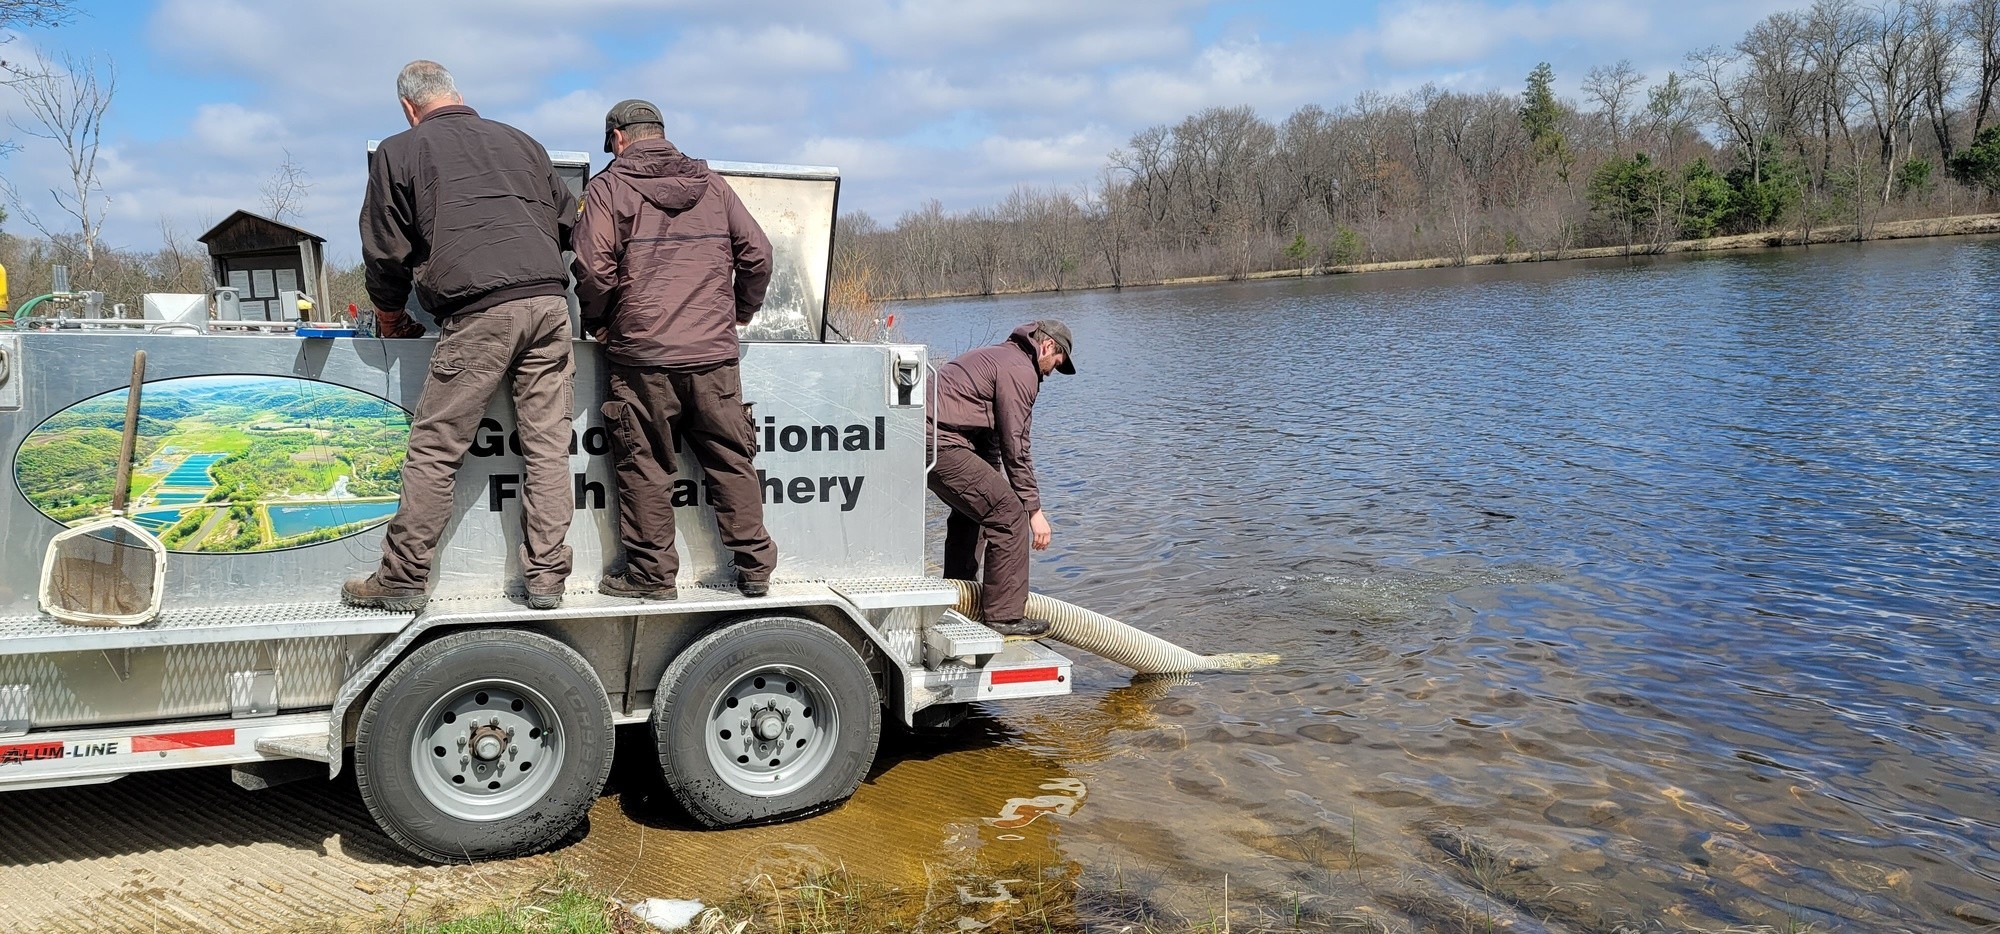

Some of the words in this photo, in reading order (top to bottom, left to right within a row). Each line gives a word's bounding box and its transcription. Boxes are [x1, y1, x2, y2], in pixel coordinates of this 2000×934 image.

[672, 416, 885, 455] ional
[488, 472, 606, 512] Fh
[670, 469, 865, 512] athery
